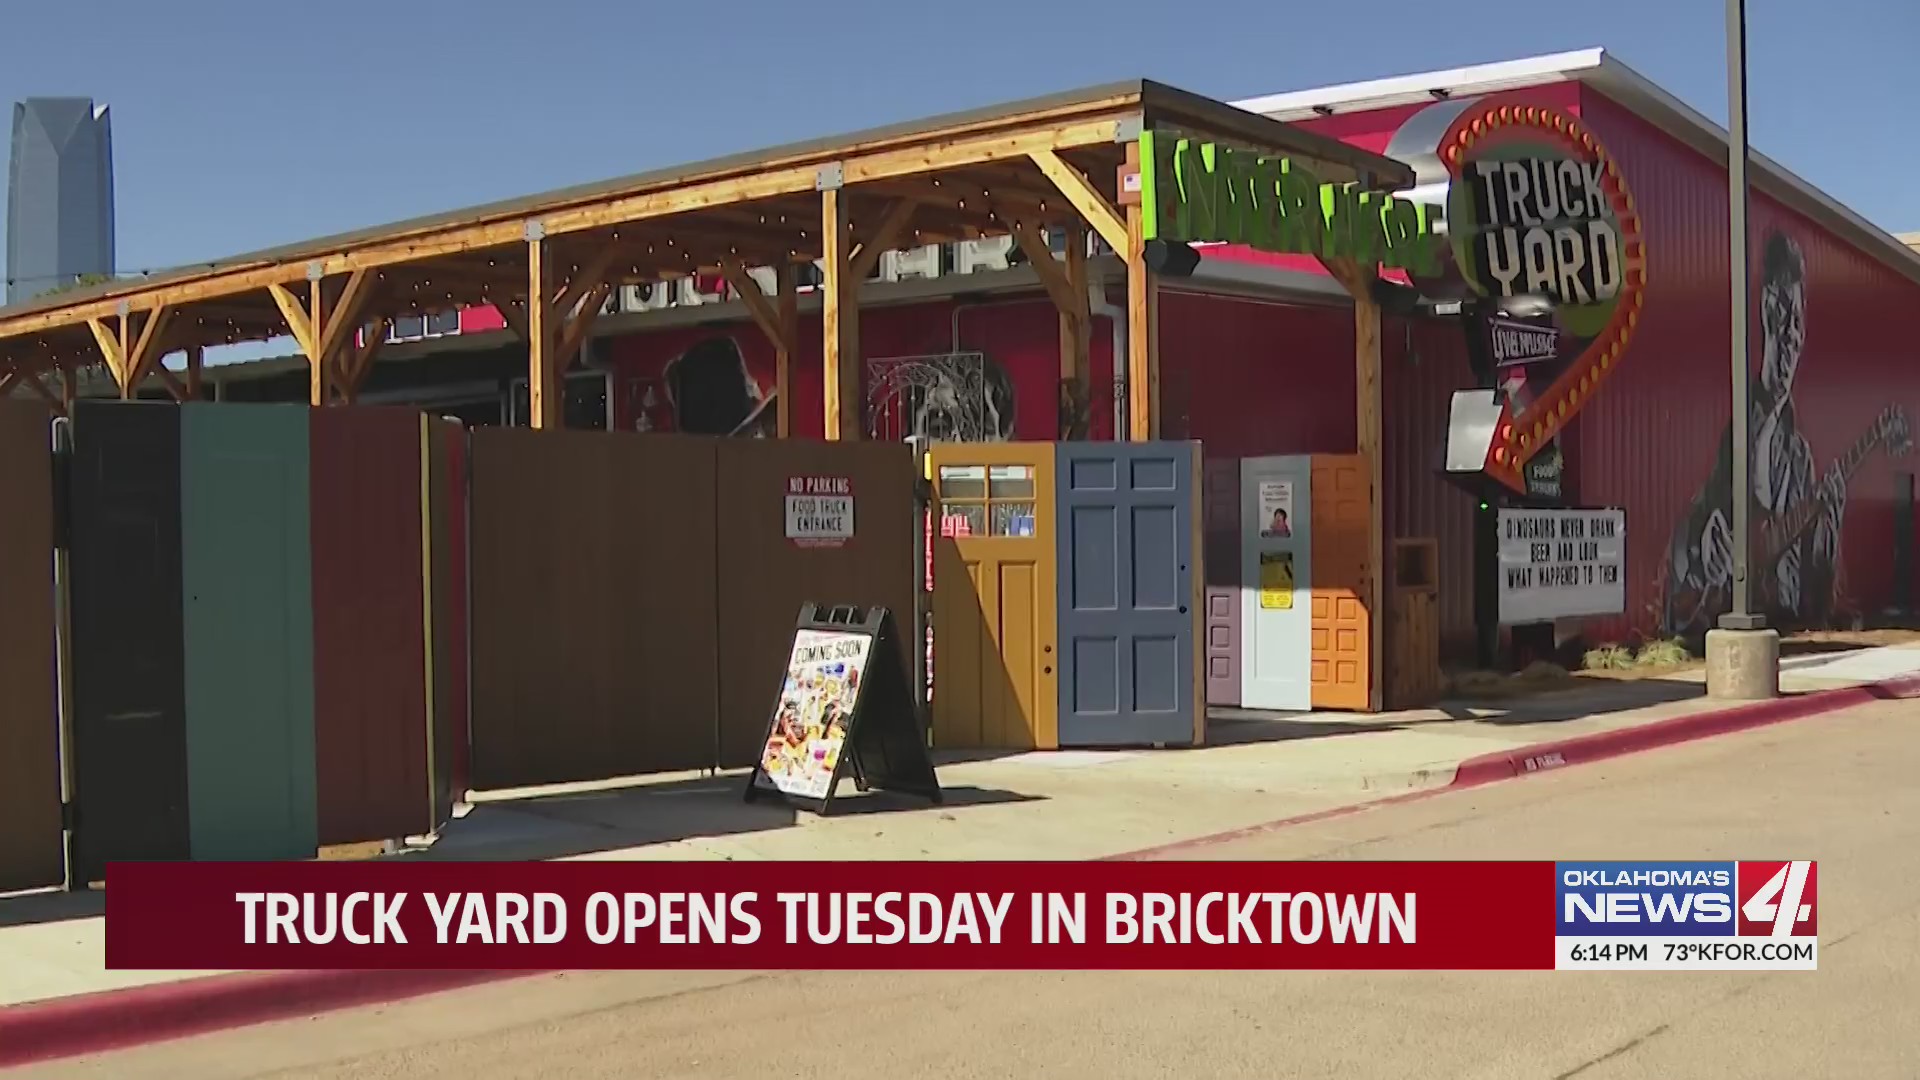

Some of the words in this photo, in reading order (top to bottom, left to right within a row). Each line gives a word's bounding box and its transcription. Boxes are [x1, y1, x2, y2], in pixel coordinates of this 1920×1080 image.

[1476, 158, 1612, 227] TRUCK
[1484, 219, 1623, 305] YARD
[789, 477, 804, 493] NO
[806, 477, 850, 494] PARKING
[792, 499, 816, 514] FOOD
[797, 516, 842, 532] ENTRANCE
[1506, 517, 1555, 538] DINOSAURS
[1560, 517, 1584, 538] NEVER
[1590, 517, 1615, 537] DRANK
[1530, 543, 1550, 563] BEER
[1557, 543, 1573, 562] AND
[1579, 543, 1598, 561] LOOK
[1507, 568, 1532, 588] WHAT
[1539, 566, 1579, 587] HAPPENED
[1583, 565, 1593, 584] TO
[1599, 564, 1618, 584] THEM
[795, 645, 833, 664] COMING
[834, 639, 863, 660] SOON
